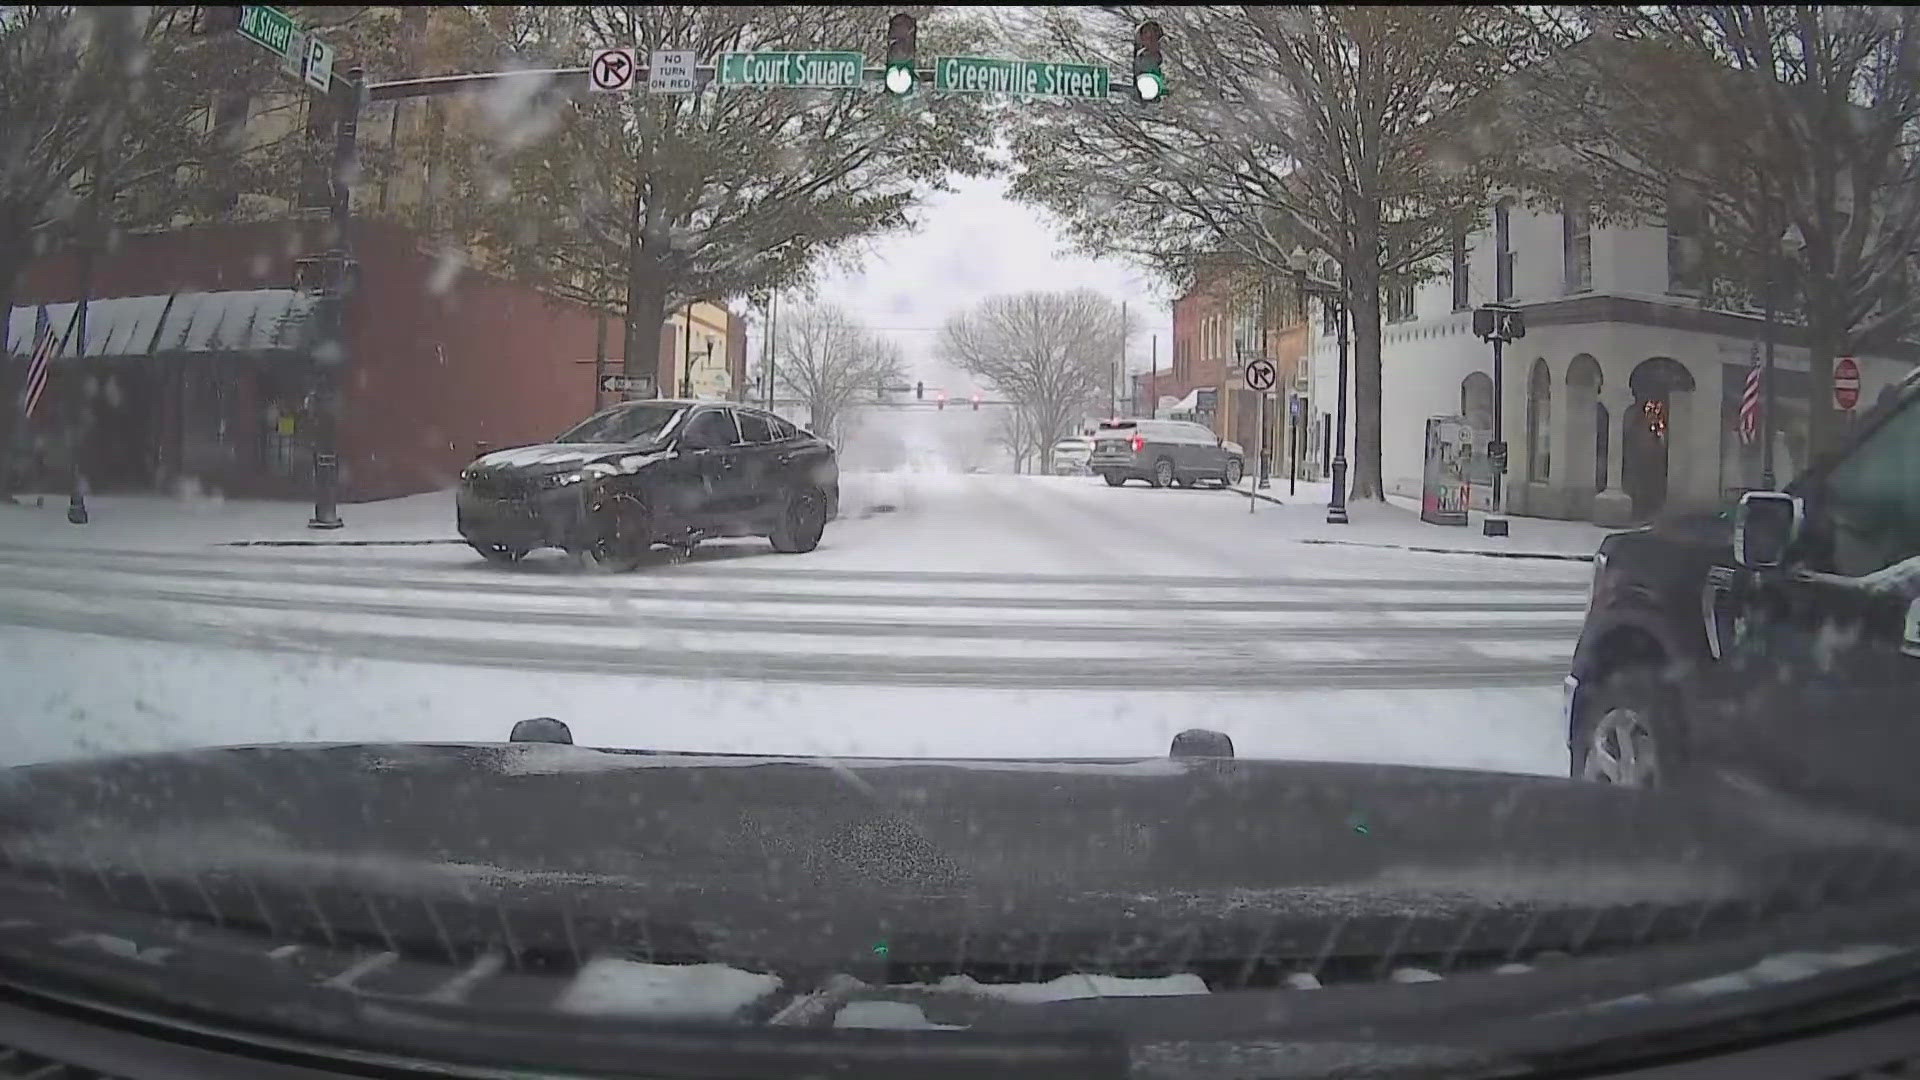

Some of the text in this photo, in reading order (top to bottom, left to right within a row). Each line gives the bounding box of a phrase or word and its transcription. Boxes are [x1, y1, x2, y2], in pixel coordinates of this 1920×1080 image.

[258, 11, 290, 52] Street
[664, 54, 682, 65] NO
[721, 54, 856, 85] E. Court Square
[659, 67, 686, 77] TURN
[945, 58, 1100, 98] Greenville Street
[651, 79, 691, 89] ON RED
